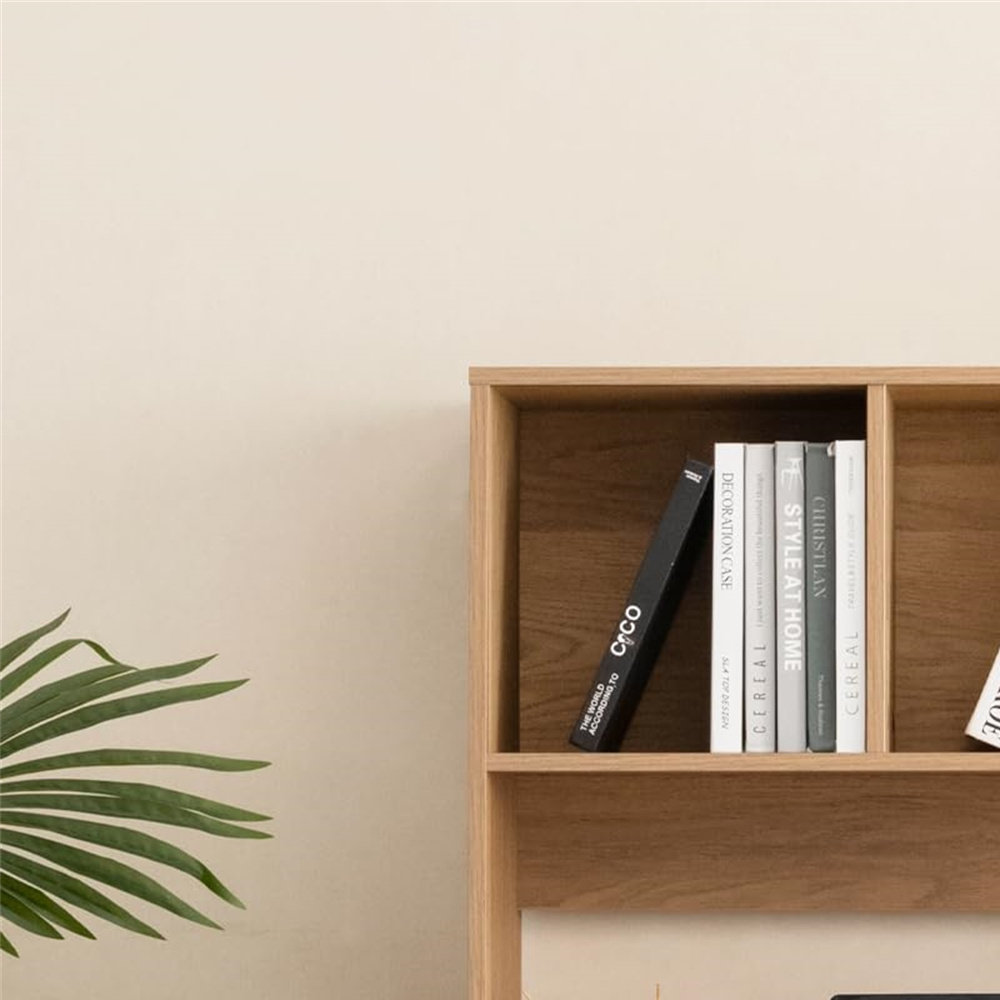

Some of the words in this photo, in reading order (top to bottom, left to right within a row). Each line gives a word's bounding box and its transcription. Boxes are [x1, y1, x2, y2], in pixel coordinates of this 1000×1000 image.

[721, 472, 735, 556] DECORATION
[783, 503, 803, 570] STYLE
[721, 557, 734, 591] CASE
[783, 575, 803, 602] AT
[720, 656, 730, 675] SLA
[783, 608, 803, 671] HOME
[589, 685, 614, 736] ACCORDING
[608, 672, 619, 685] TO
[752, 644, 767, 734] CEREAL
[844, 631, 860, 716] CEREAL
[580, 714, 593, 731] THE
[587, 683, 605, 714] WORLD
[720, 693, 730, 730] DESIGN
